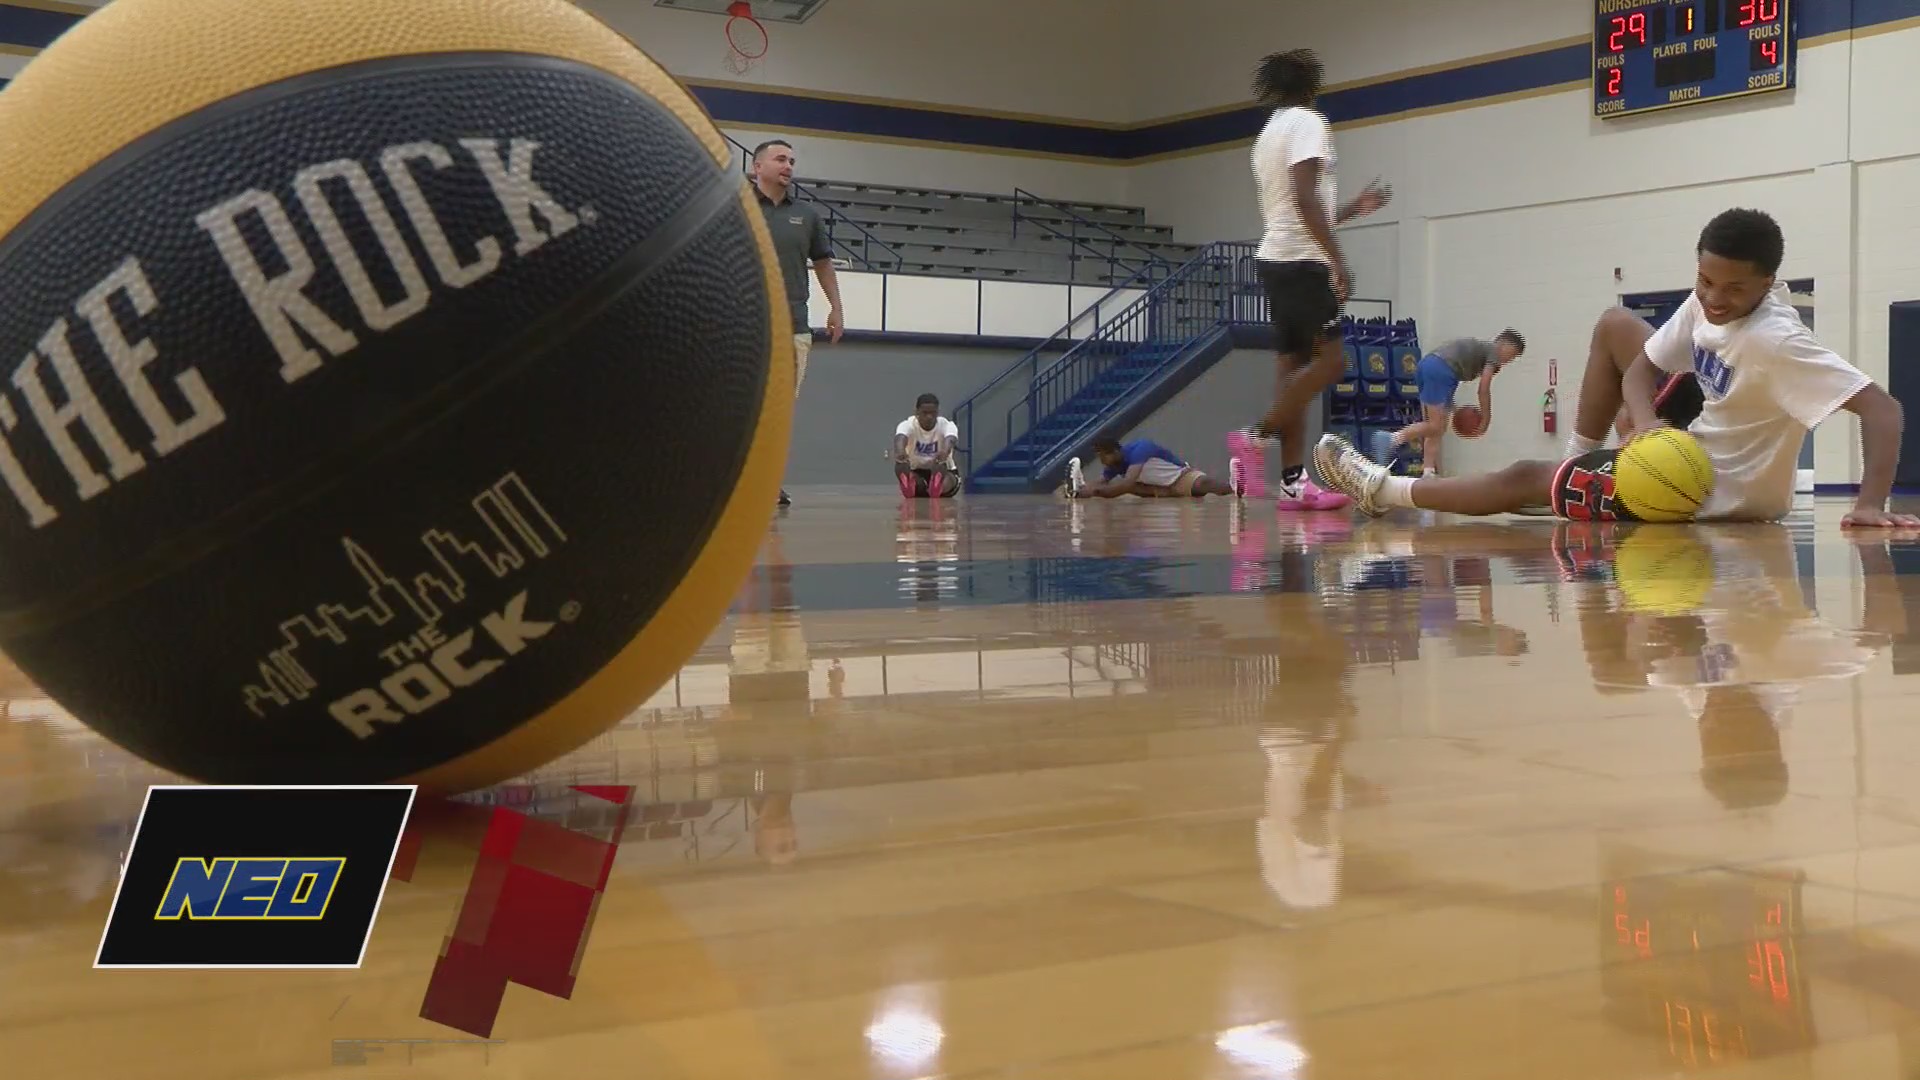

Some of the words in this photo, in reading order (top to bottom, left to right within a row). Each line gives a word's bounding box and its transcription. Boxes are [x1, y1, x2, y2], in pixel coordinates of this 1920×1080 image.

[1599, 0, 1666, 14] NORSEM
[1687, 7, 1694, 31] 1
[1740, 0, 1778, 25] 30
[1609, 12, 1645, 51] 29
[1749, 23, 1781, 41] FOULS
[1653, 42, 1687, 58] PLAYER
[1693, 36, 1718, 51] FOUL
[1762, 40, 1776, 64] 4
[1597, 53, 1625, 69] FOULS
[1608, 68, 1621, 94] 2
[1748, 72, 1780, 88] SCORE
[1669, 86, 1701, 101] MATCH
[1597, 99, 1626, 114] SCORE
[0, 255, 227, 530] THE
[196, 136, 583, 385] ROCK
[378, 625, 448, 667] THE
[327, 589, 557, 740] ROCK
